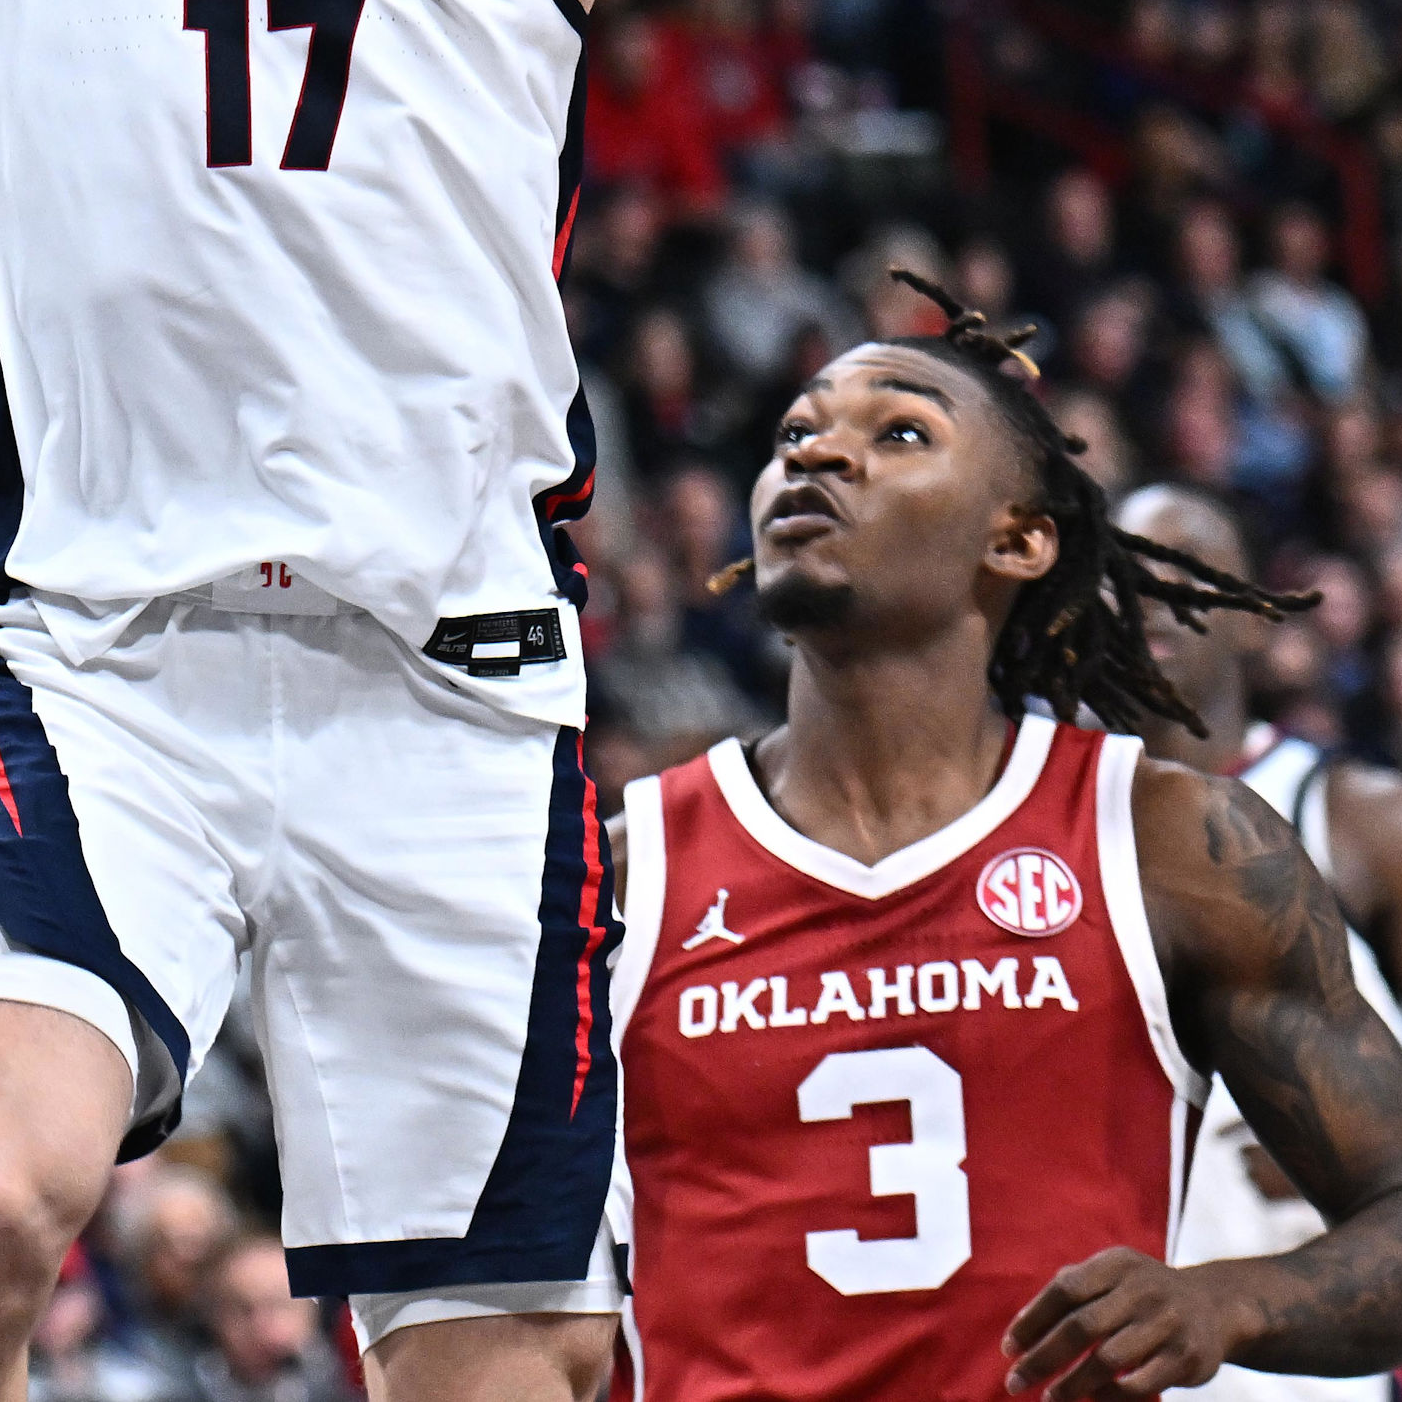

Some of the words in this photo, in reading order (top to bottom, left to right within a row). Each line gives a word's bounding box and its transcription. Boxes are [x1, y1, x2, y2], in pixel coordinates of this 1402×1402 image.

[988, 857, 1076, 930] SEC
[679, 956, 1079, 1038] OKLAHOMA
[798, 1046, 971, 1296] 3
